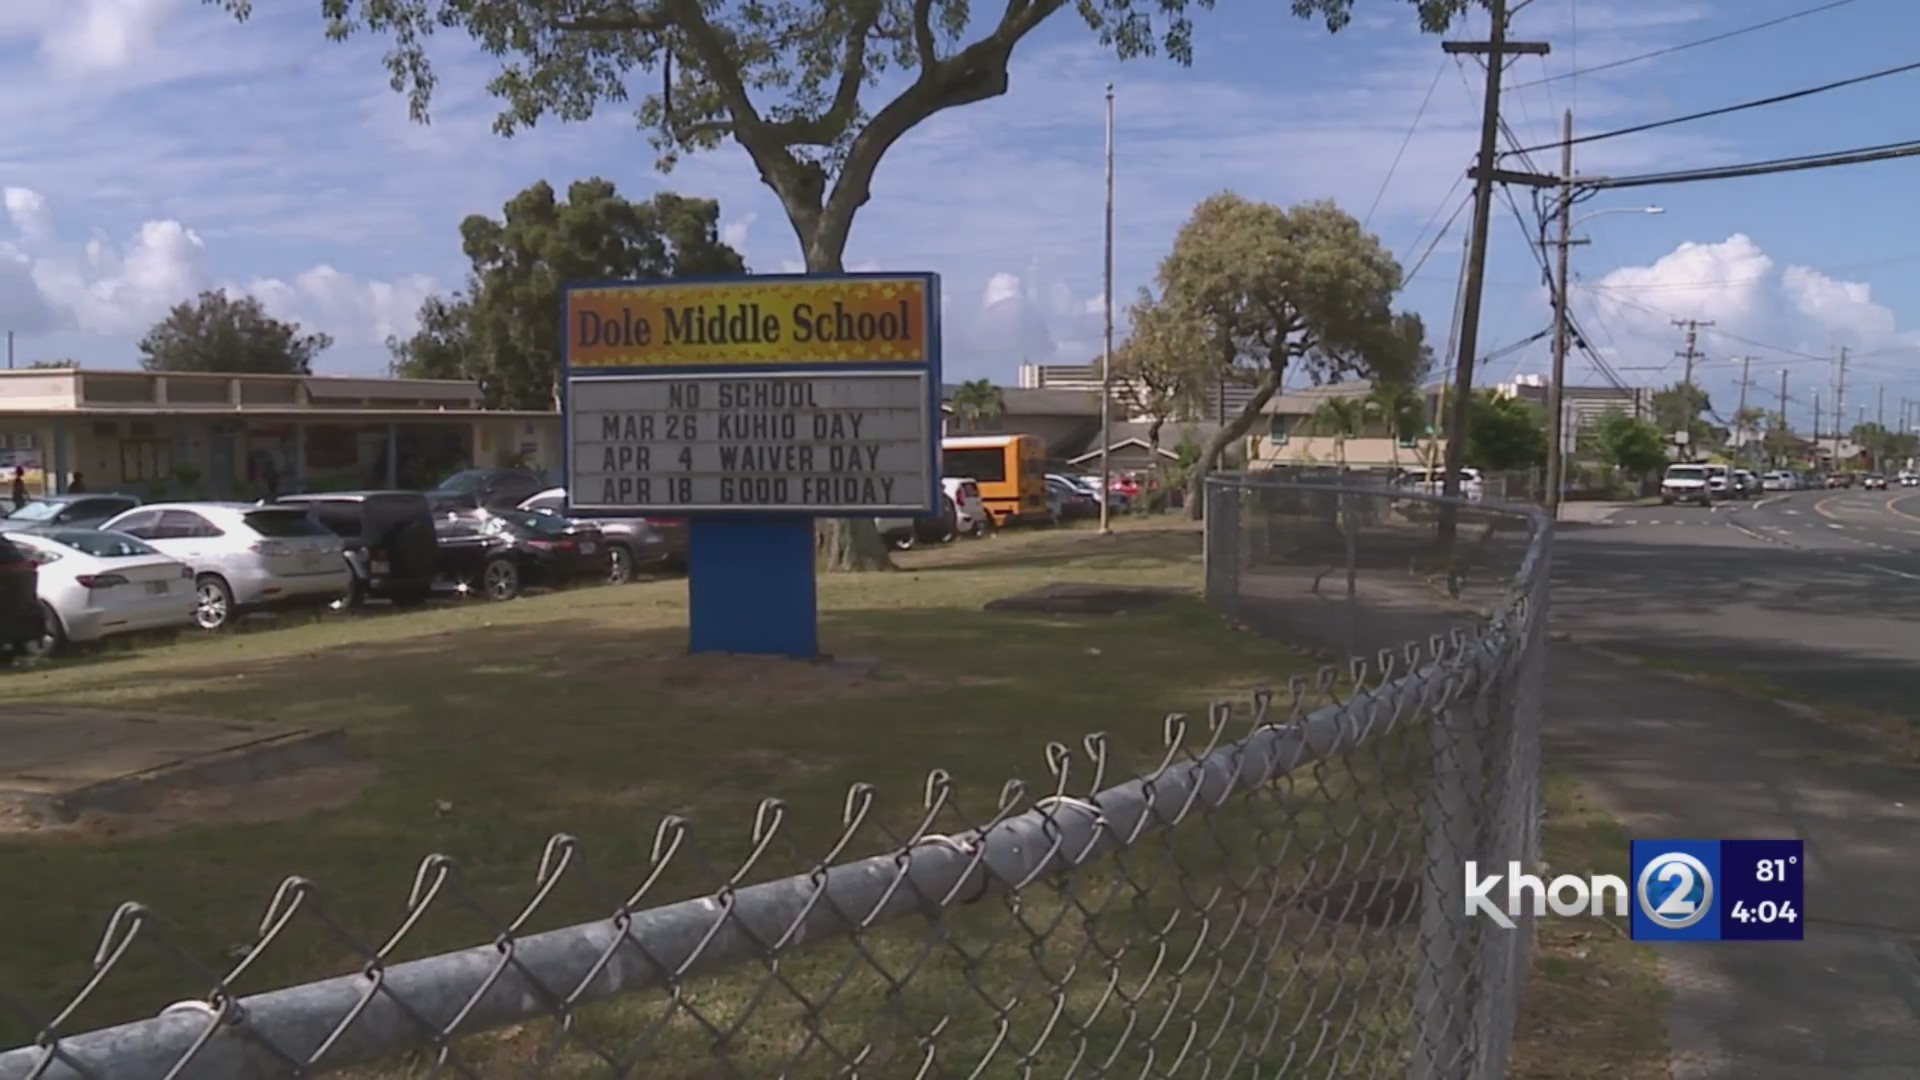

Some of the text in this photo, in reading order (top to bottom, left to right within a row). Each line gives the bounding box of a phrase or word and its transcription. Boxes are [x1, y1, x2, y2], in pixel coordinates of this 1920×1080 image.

[578, 299, 912, 349] Dole Middle School
[669, 383, 819, 407] NO SCHOOL
[602, 412, 864, 440] MAR 26 KUHIO DAY
[602, 446, 880, 472] APR 4 WAIVER DAY
[602, 476, 895, 504] APR 18 GOOD FRIDAY
